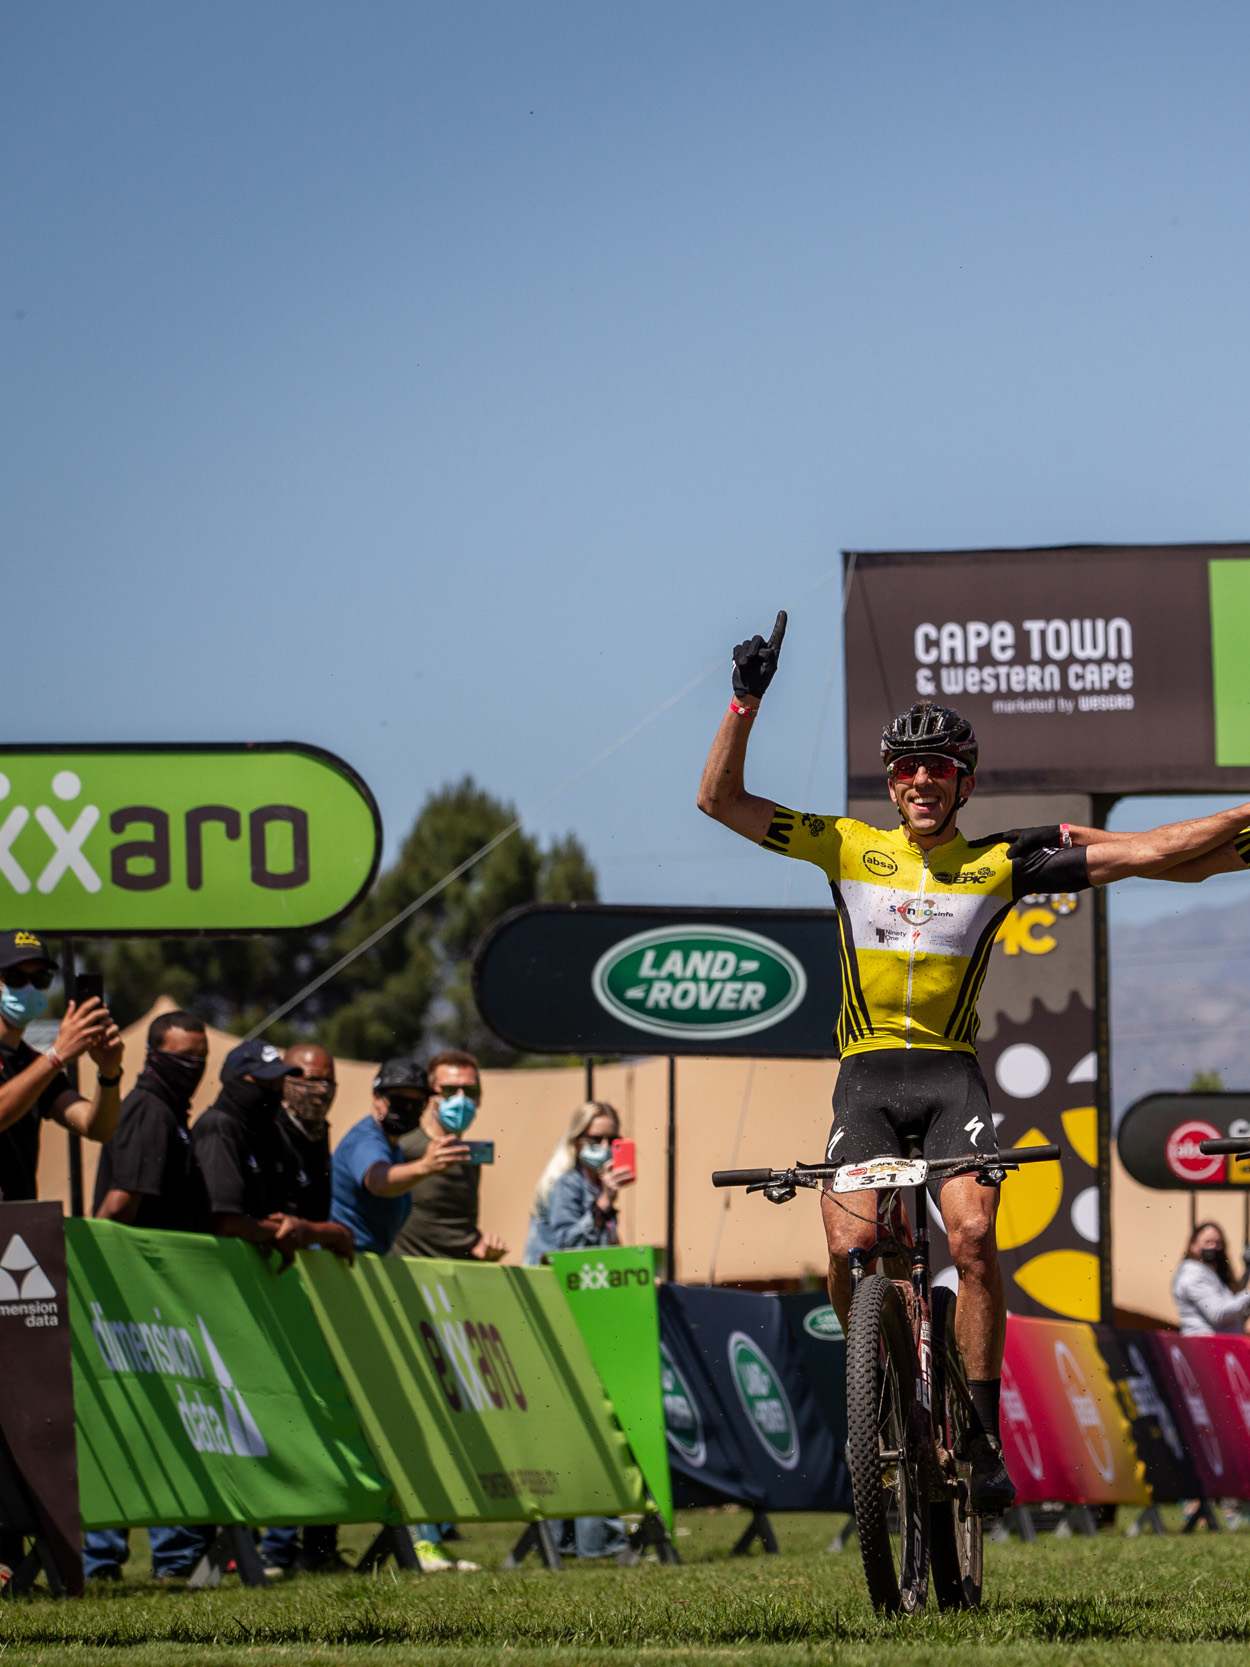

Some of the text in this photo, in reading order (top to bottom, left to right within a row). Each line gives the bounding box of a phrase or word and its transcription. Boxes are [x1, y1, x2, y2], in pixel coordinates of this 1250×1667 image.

[914, 617, 1133, 665] CAPE TOWN
[915, 667, 937, 696] &
[1067, 662, 1134, 691] CAPE
[1057, 695, 1075, 715] by
[866, 856, 894, 870] absa
[952, 875, 987, 884] EPIC
[885, 929, 907, 938] Ninety
[638, 949, 738, 980] LAND
[644, 980, 767, 1011] ROVER
[859, 1173, 898, 1185] 3-1
[869, 1165, 908, 1174] EPIC
[566, 1262, 650, 1291] exxaro
[0, 1301, 58, 1317] mension
[24, 1314, 59, 1328] data
[90, 1301, 206, 1379] dimension
[419, 1283, 528, 1413] exxaro
[175, 1383, 234, 1456] data
